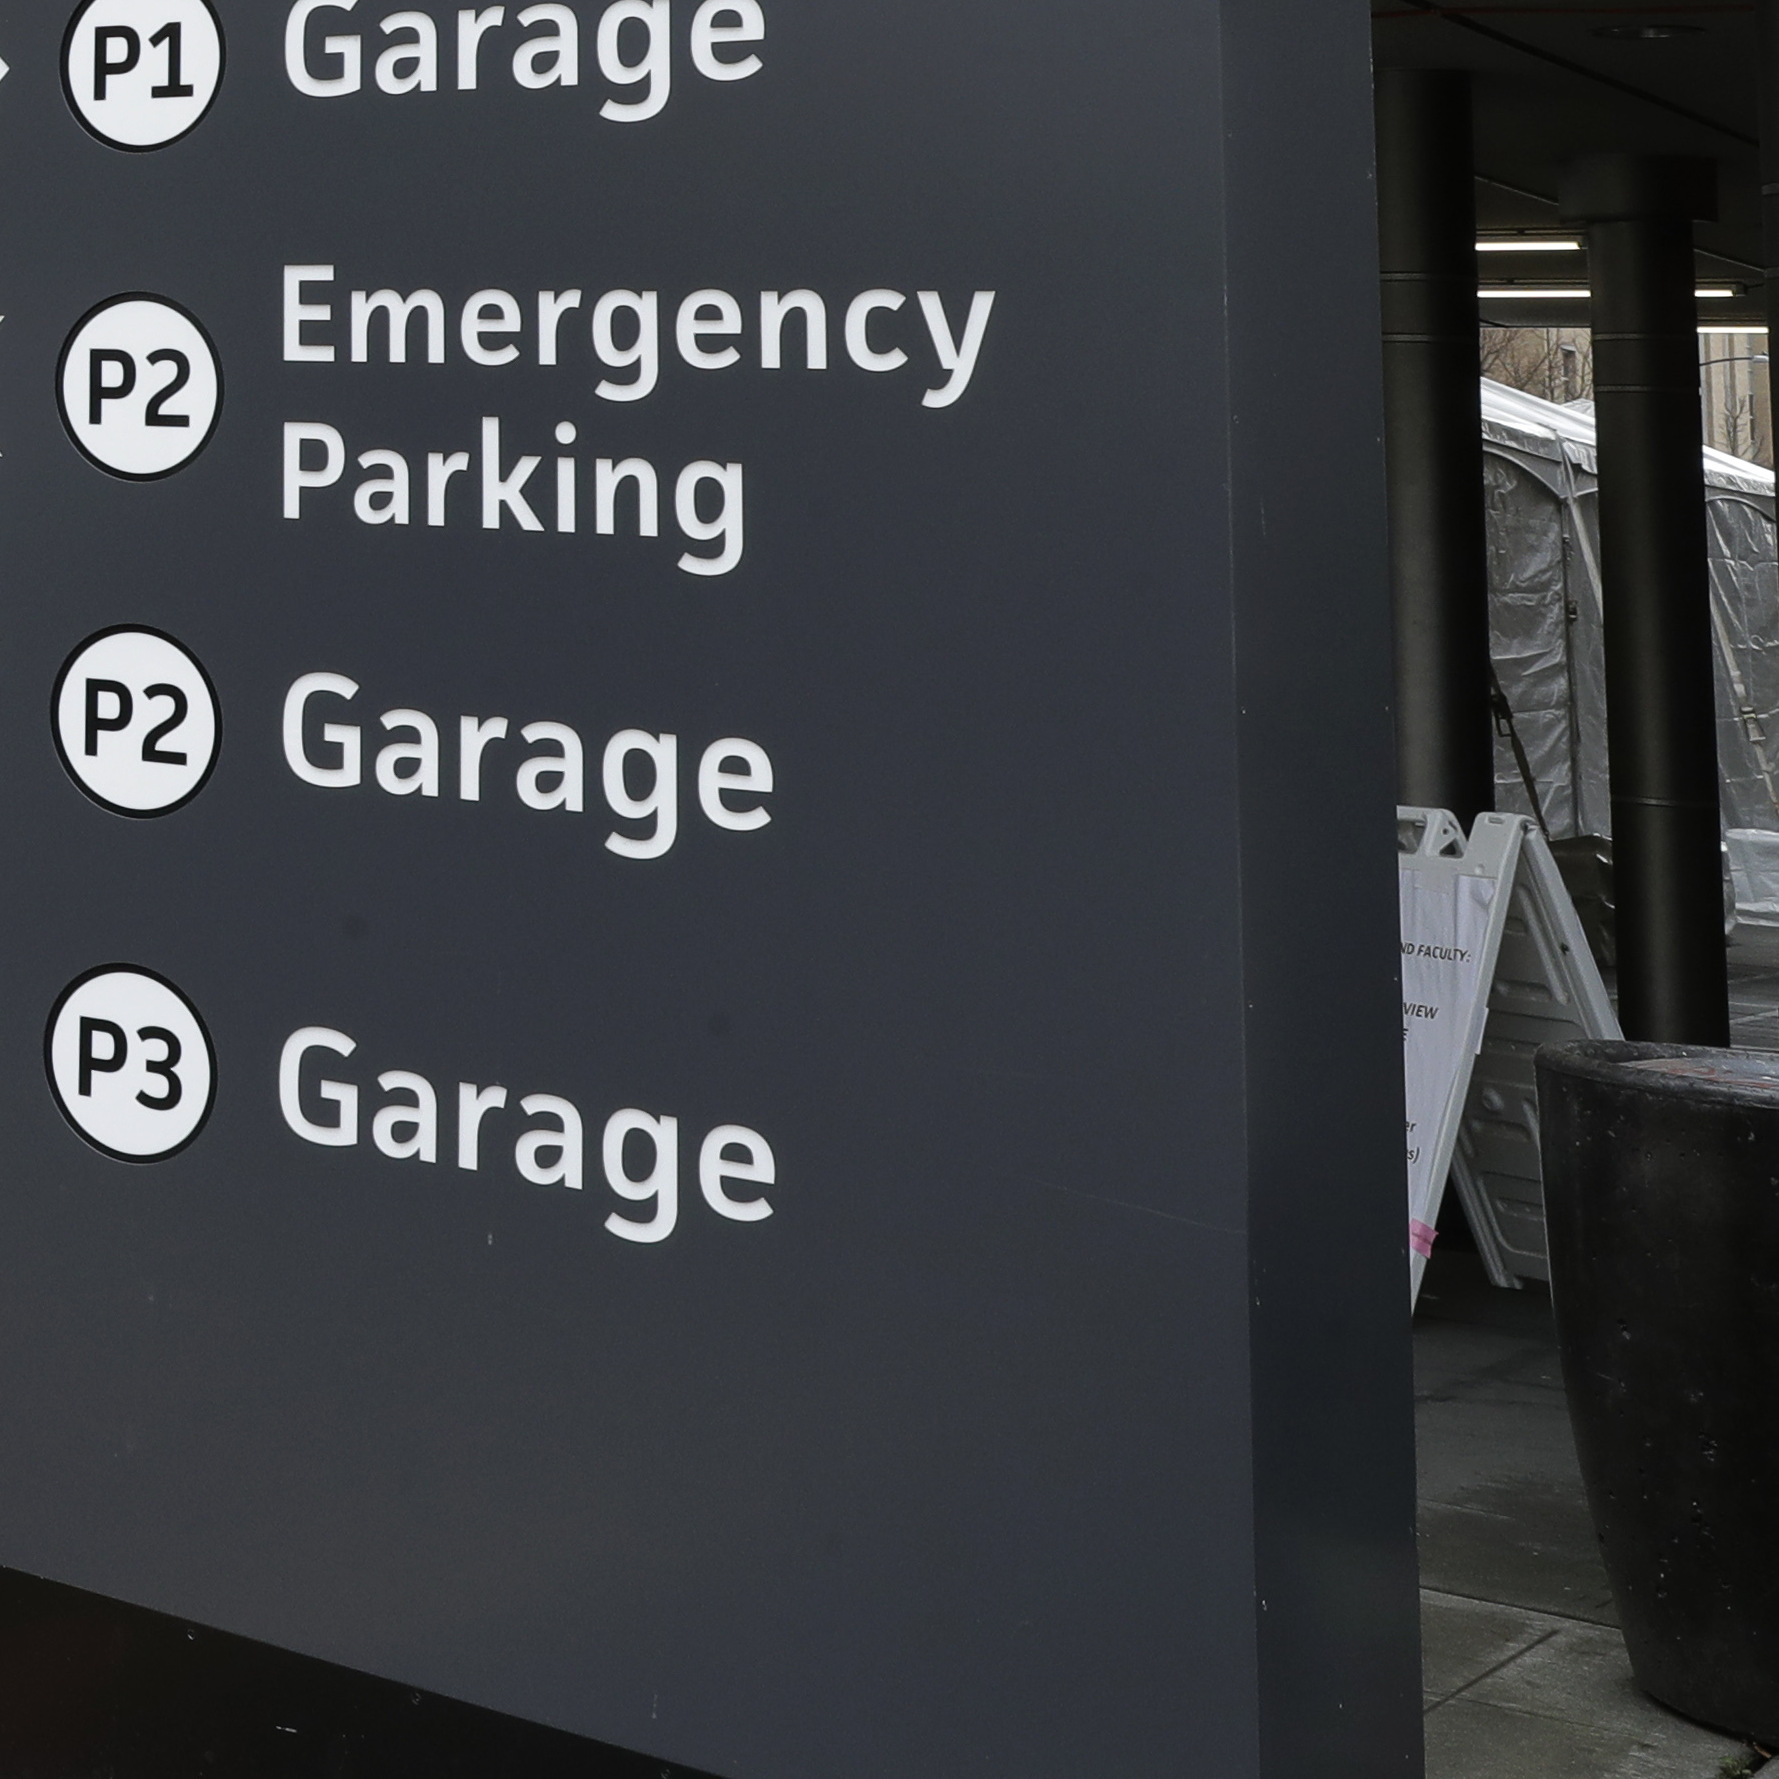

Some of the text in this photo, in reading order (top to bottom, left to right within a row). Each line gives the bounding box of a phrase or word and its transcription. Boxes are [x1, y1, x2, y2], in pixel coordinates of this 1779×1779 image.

[94, 22, 193, 100] P1
[89, 266, 995, 427] P2 Emergency
[284, 417, 742, 575] Parking
[85, 673, 772, 859] P2 Garage
[1401, 942, 1472, 963] ND FACULTY:
[1403, 1002, 1439, 1019] VIEW
[79, 1017, 774, 1242] P3 Garage
